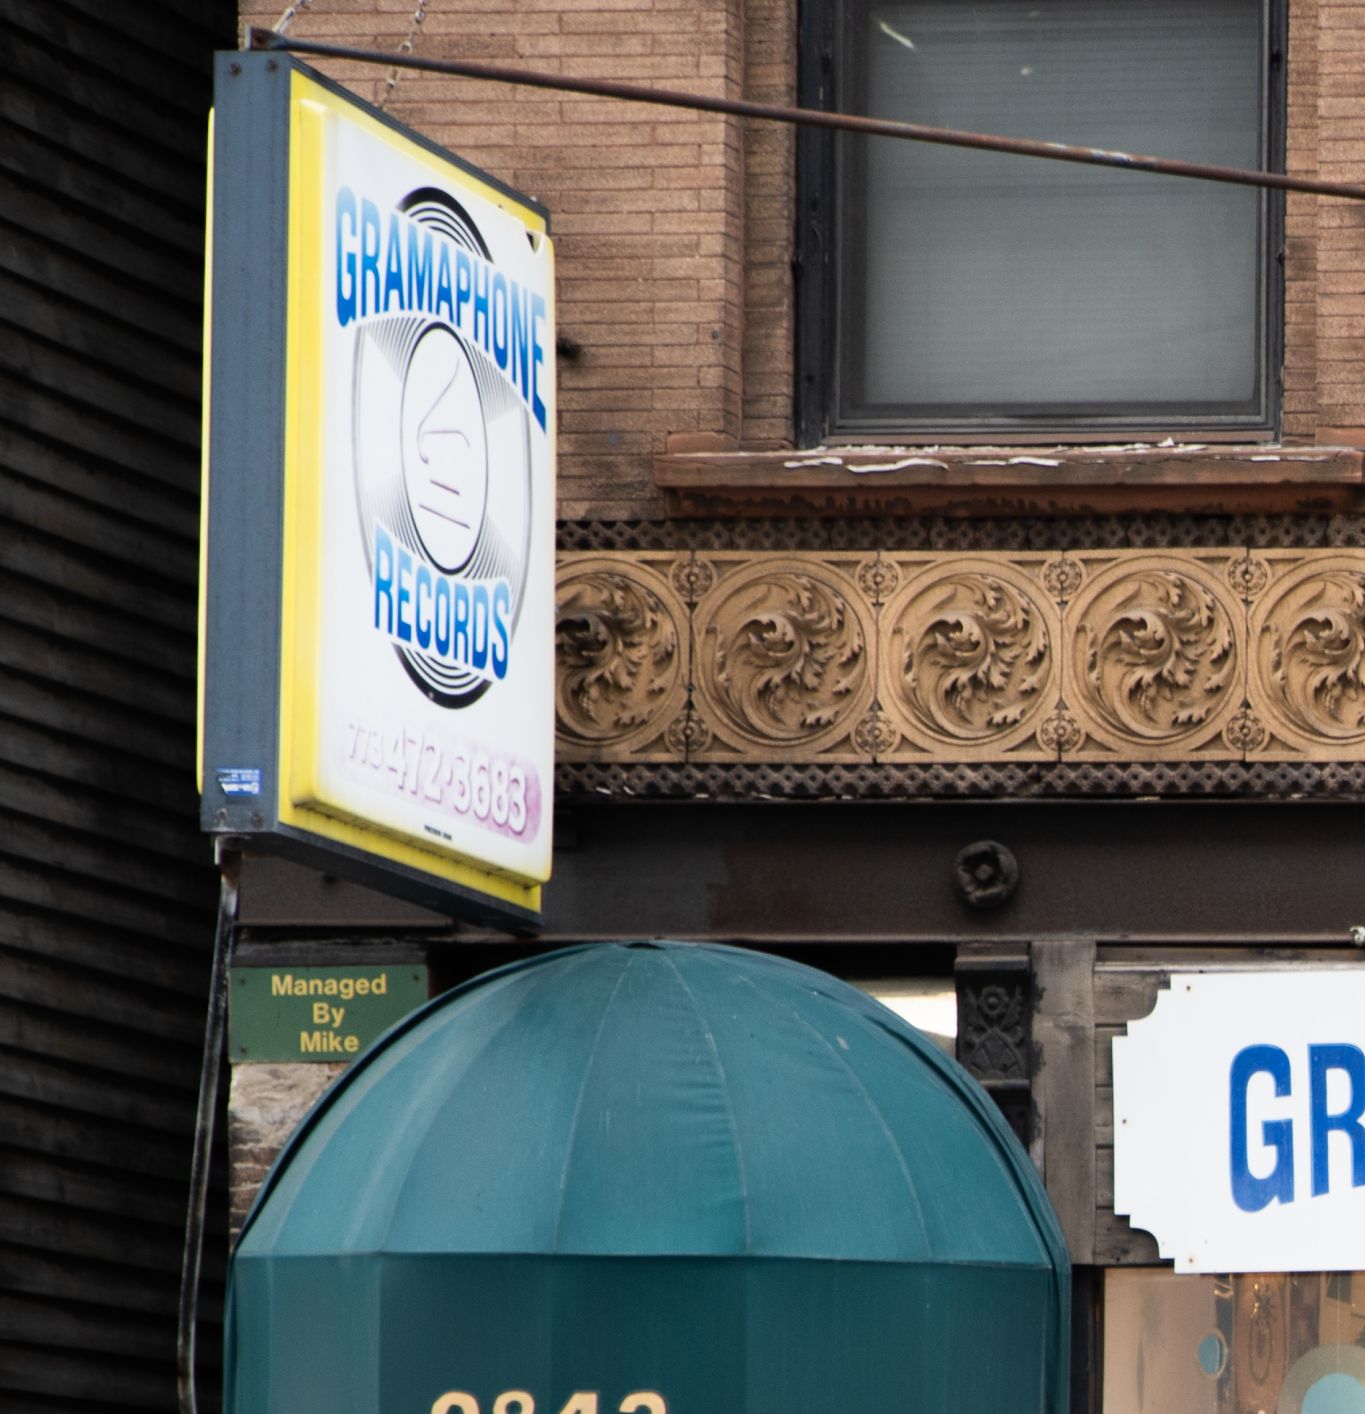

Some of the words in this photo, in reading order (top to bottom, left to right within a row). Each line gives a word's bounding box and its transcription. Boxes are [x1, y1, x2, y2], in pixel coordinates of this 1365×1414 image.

[335, 186, 547, 435] GRAMAPHONE
[373, 518, 511, 683] RECORDS
[271, 973, 387, 998] Managed
[312, 1002, 345, 1027] By
[300, 1031, 360, 1052] Mike
